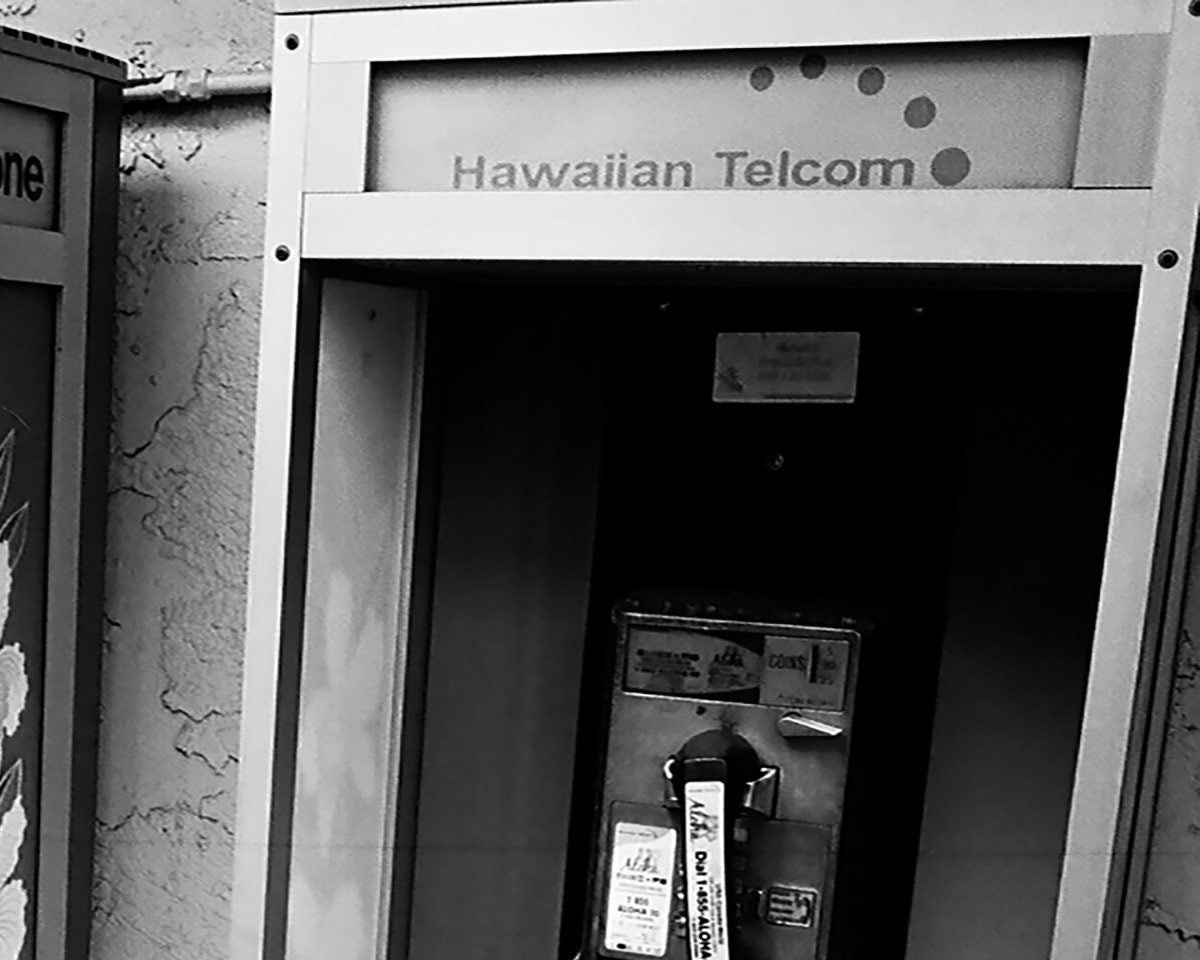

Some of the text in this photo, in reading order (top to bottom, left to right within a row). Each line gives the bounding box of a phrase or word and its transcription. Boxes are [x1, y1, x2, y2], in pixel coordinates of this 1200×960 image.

[452, 150, 915, 190] Hawaiian Telcom
[695, 851, 708, 876] Dial
